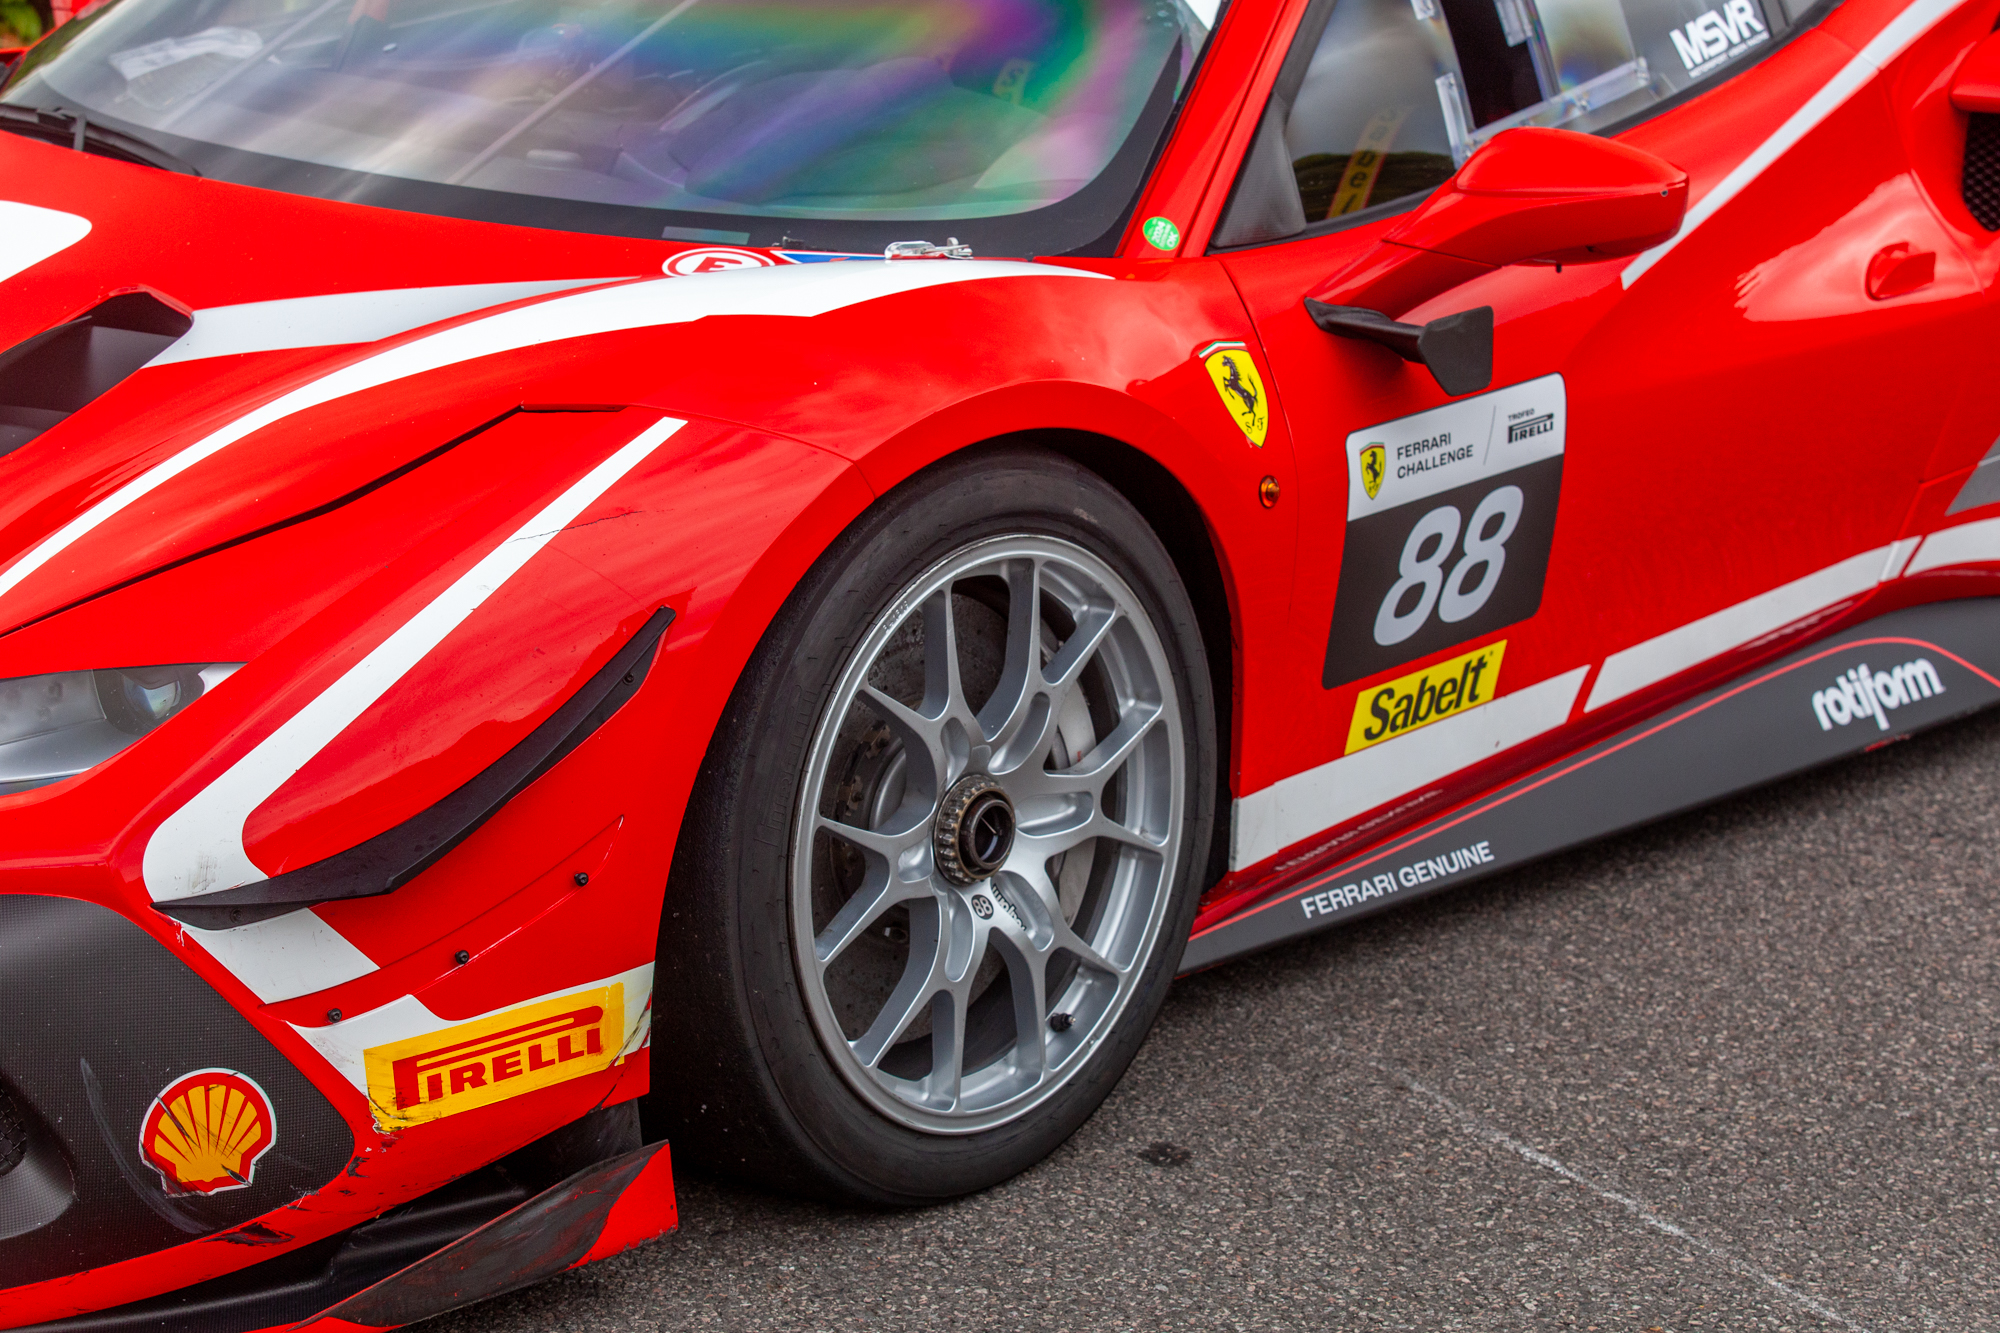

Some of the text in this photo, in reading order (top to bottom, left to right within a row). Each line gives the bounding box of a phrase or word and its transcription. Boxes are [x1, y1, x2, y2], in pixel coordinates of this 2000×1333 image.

[1669, 0, 1765, 70] MSVR
[1396, 432, 1452, 461] FERRARI
[1507, 413, 1555, 444] PIRELLI
[1508, 407, 1536, 422] TROFEO
[1396, 444, 1475, 479] CHALLENGE
[1373, 484, 1525, 647] 88
[1363, 653, 1489, 742] Sabelt
[1811, 657, 1947, 731] rotiform
[1300, 840, 1496, 919] FERRARI GENUINE
[392, 1005, 604, 1111] PIRELLI
